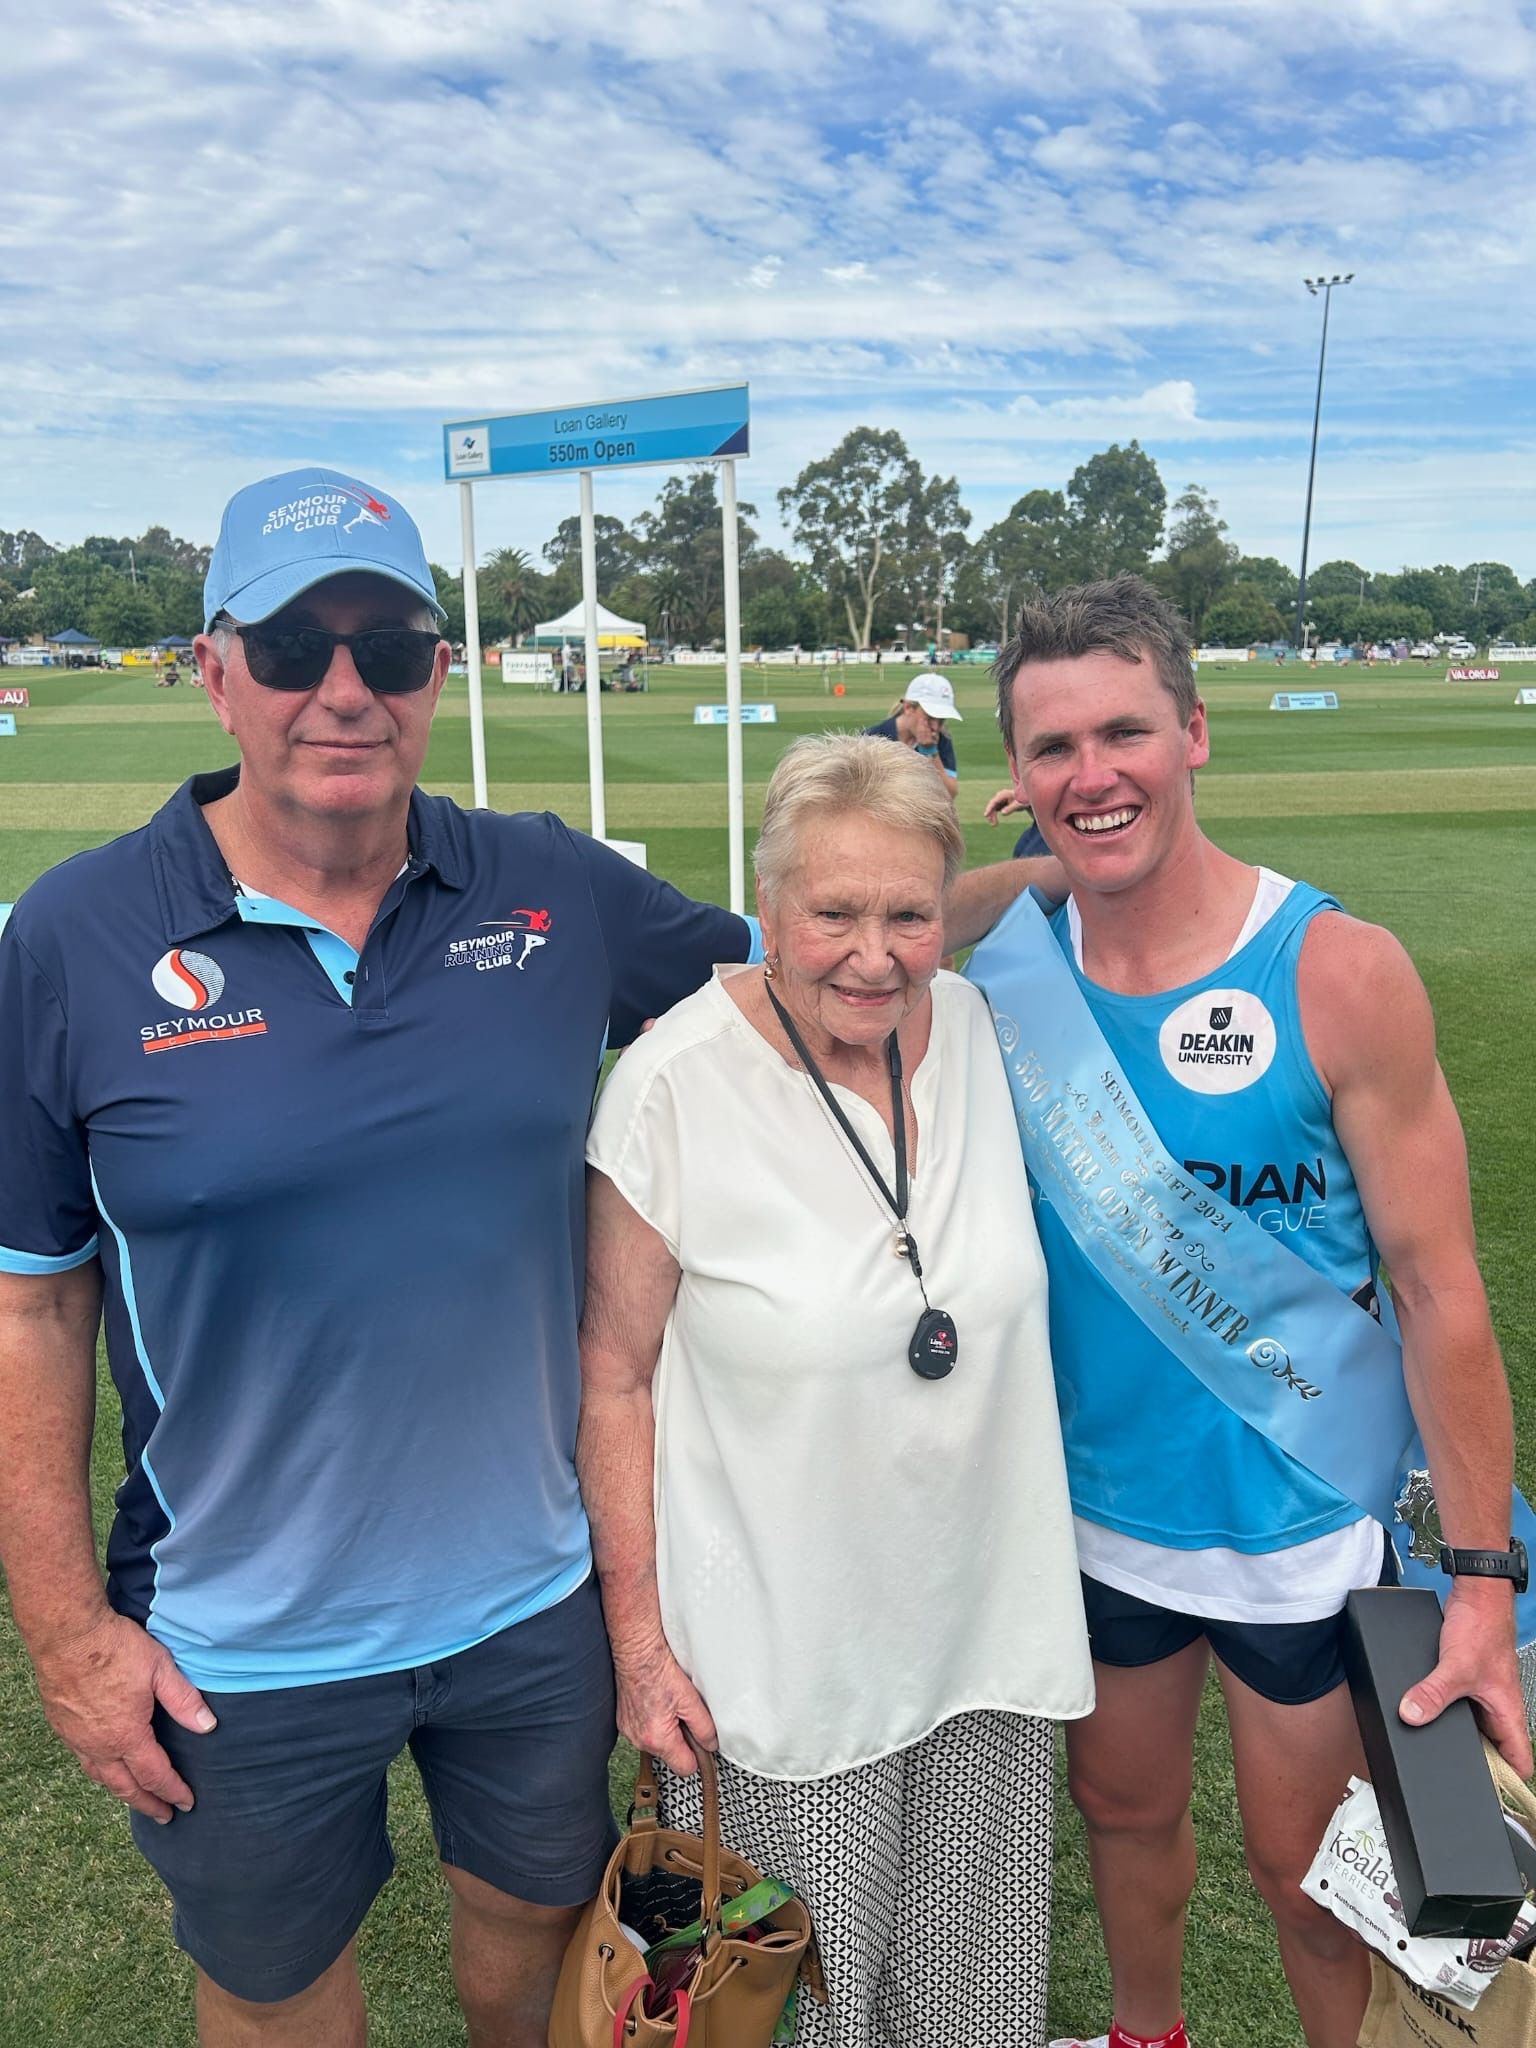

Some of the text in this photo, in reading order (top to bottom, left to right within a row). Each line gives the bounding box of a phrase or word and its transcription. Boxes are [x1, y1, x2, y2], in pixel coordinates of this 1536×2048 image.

[554, 412, 628, 434] Loan Gallery
[549, 440, 635, 463] 550m Open
[263, 505, 341, 536] RUNNING
[268, 494, 347, 522] SEYMOUR
[294, 515, 338, 532] CLUB
[444, 942, 513, 967] RUNNING
[449, 931, 515, 954] SEYMOUR
[476, 954, 512, 971] CLUB
[140, 1008, 264, 1041] SEYMOUR
[168, 1028, 241, 1045] CLUB
[1180, 1033, 1254, 1053] DEAKIN
[1178, 1052, 1253, 1066] UNIVERSITY
[1101, 1070, 1233, 1233] SEYMOUR GIFT 2024
[1184, 1157, 1327, 1207] RIAN
[1016, 1050, 1049, 1102] 550
[1040, 1102, 1103, 1187] METRE
[1098, 1186, 1152, 1252] OPEN
[1151, 1248, 1249, 1346] WINNER
[1120, 1169, 1185, 1243] Gallery
[1241, 1204, 1327, 1234] GUE
[1329, 1830, 1389, 1890] Koala
[1323, 1856, 1377, 1900] CHERRIES
[1334, 1892, 1391, 1942] Australian Cherries
